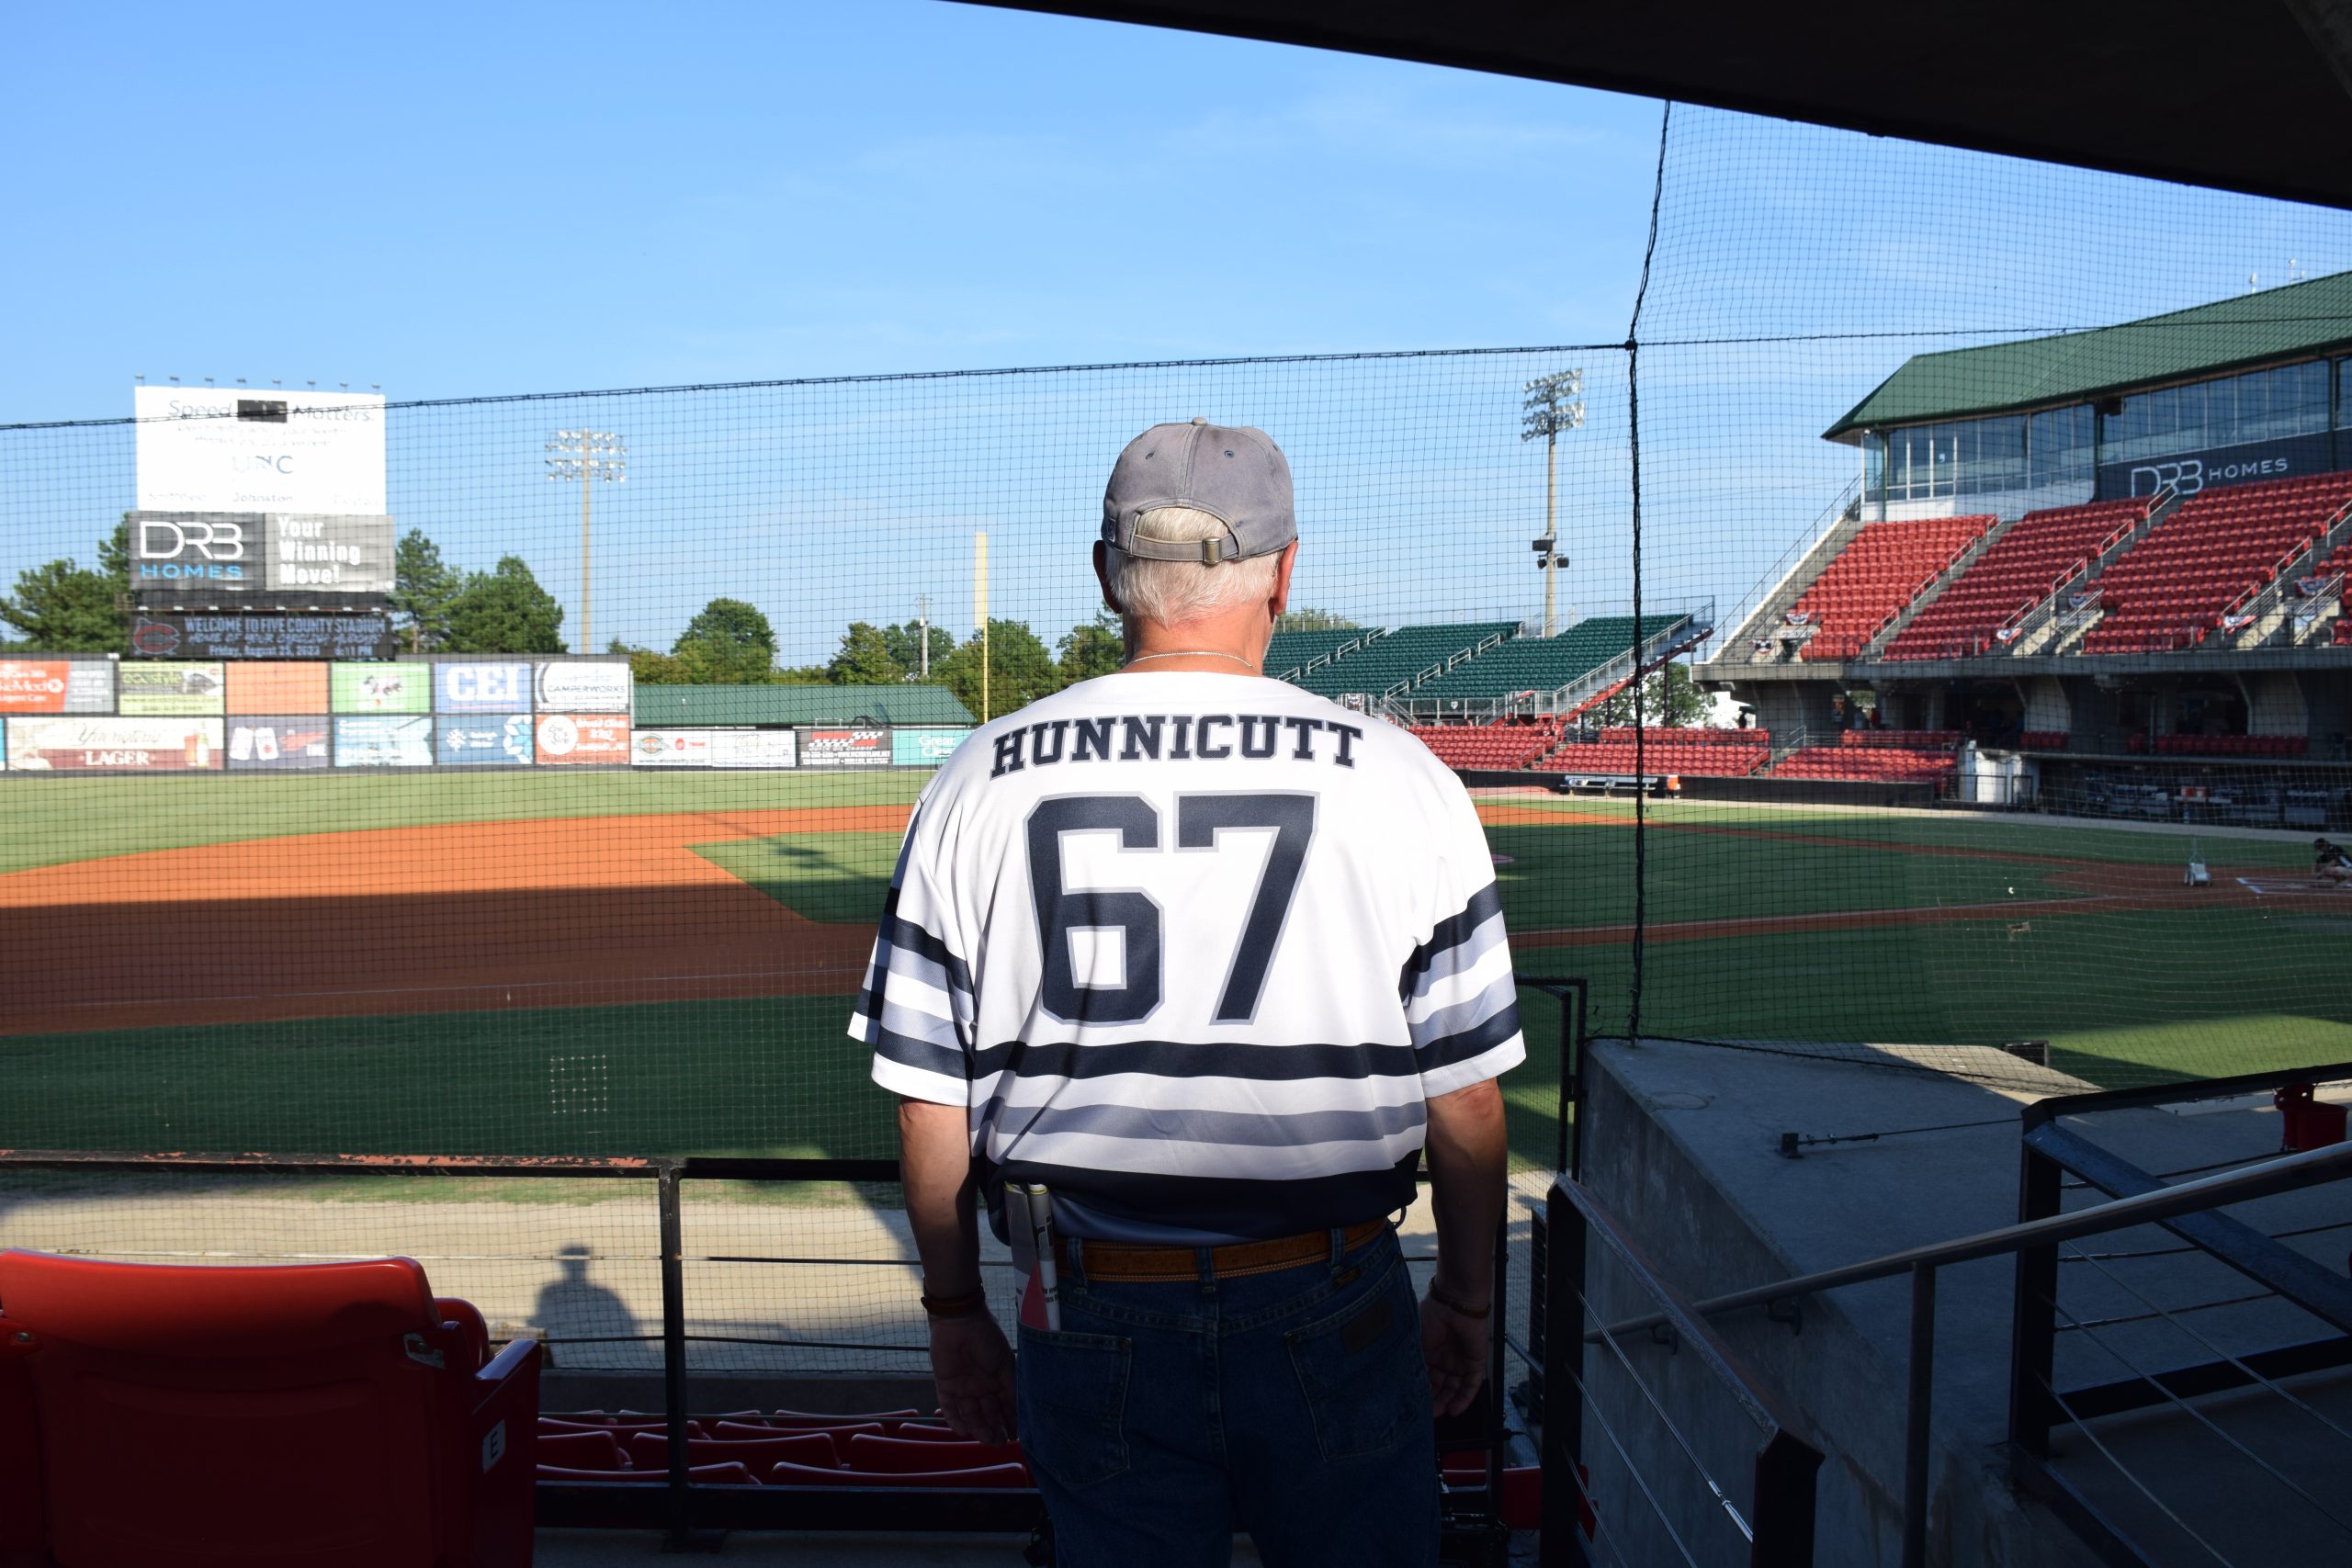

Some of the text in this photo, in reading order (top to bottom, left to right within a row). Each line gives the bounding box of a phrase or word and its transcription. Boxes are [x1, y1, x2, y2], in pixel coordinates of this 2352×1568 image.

[2208, 457, 2290, 482] HOMES
[278, 516, 325, 538] Your
[140, 521, 244, 561] DRB
[278, 540, 362, 566] Winning
[140, 564, 244, 580] HOMES
[279, 564, 341, 585] Move!
[185, 617, 386, 634] WELCOME TO FIVE COUNTY STADIUM
[209, 645, 243, 658] Friday,
[243, 645, 277, 659] August
[446, 665, 520, 701] CEI
[548, 685, 627, 694] CAMPERWORKS
[919, 735, 956, 747] Great
[989, 713, 1364, 781] HUNNICUTT
[85, 750, 151, 766] LAGER
[1023, 788, 1321, 1029] 67
[491, 1430, 499, 1460] E
